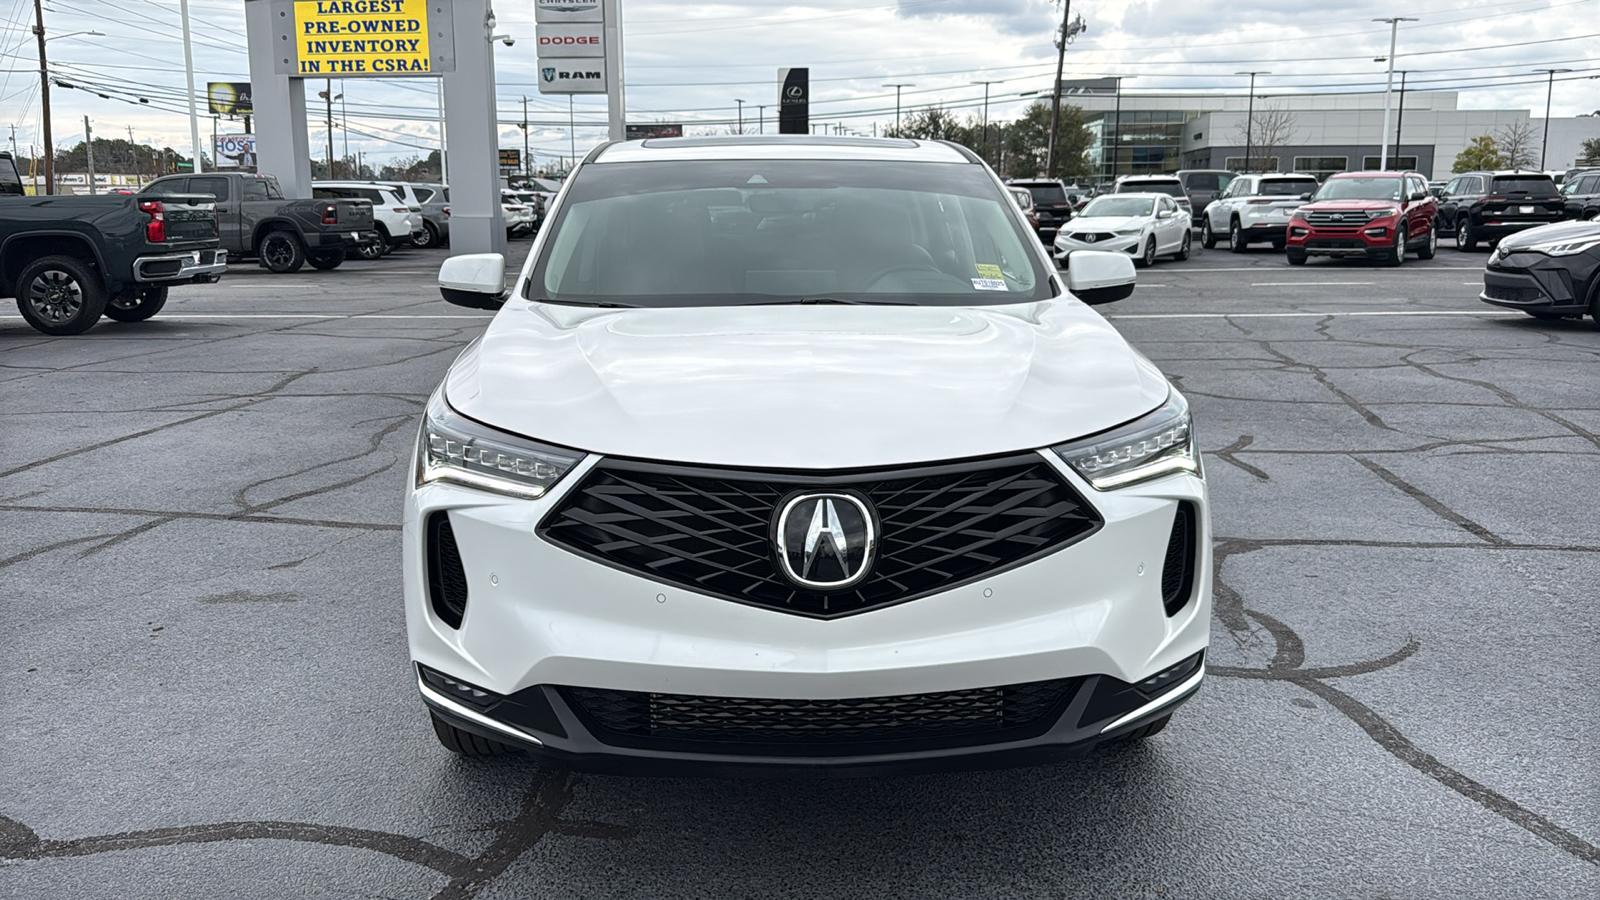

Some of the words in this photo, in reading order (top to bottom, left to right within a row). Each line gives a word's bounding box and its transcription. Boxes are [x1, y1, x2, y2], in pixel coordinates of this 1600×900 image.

[317, 0, 404, 14] LARGEST
[304, 20, 420, 34] PRE-OWNED
[306, 39, 420, 53] INVENTORY
[540, 36, 600, 45] DODGE
[300, 60, 320, 72] IN
[327, 60, 366, 72] THE
[372, 58, 428, 72] CSRA!
